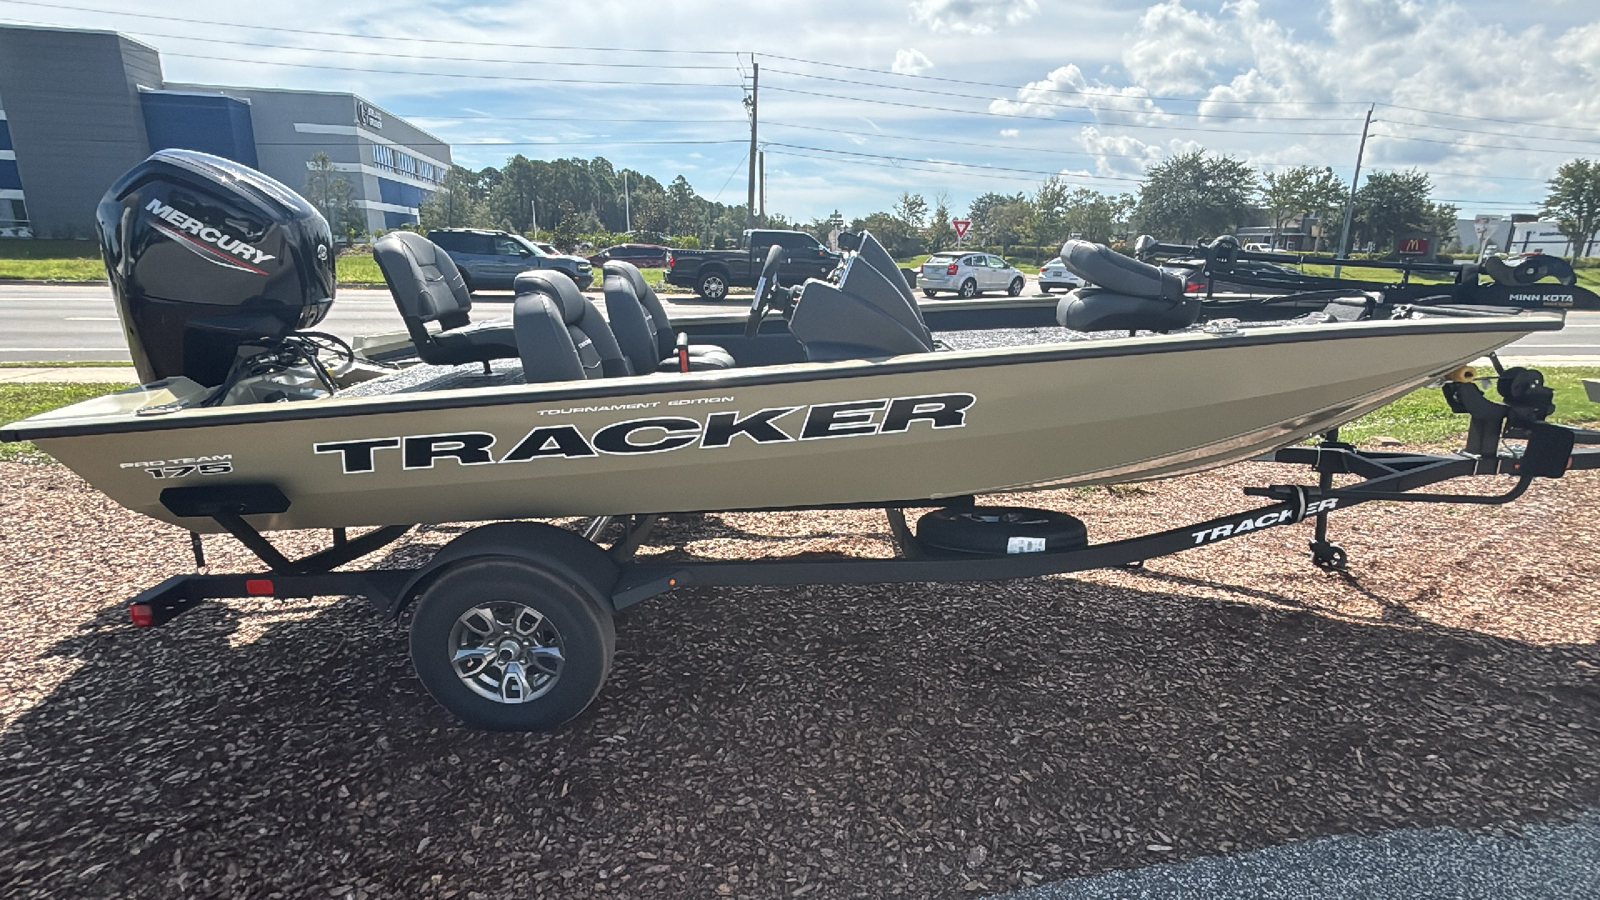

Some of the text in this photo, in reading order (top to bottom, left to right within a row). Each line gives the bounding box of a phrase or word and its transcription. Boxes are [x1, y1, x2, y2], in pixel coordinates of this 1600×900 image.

[145, 198, 276, 264] MERCURY
[1542, 294, 1574, 302] KOTA
[537, 396, 734, 416] TOURNAMENT EDITION
[313, 393, 976, 474] TRACKER
[168, 454, 233, 464] TEAM
[144, 461, 234, 479] 175
